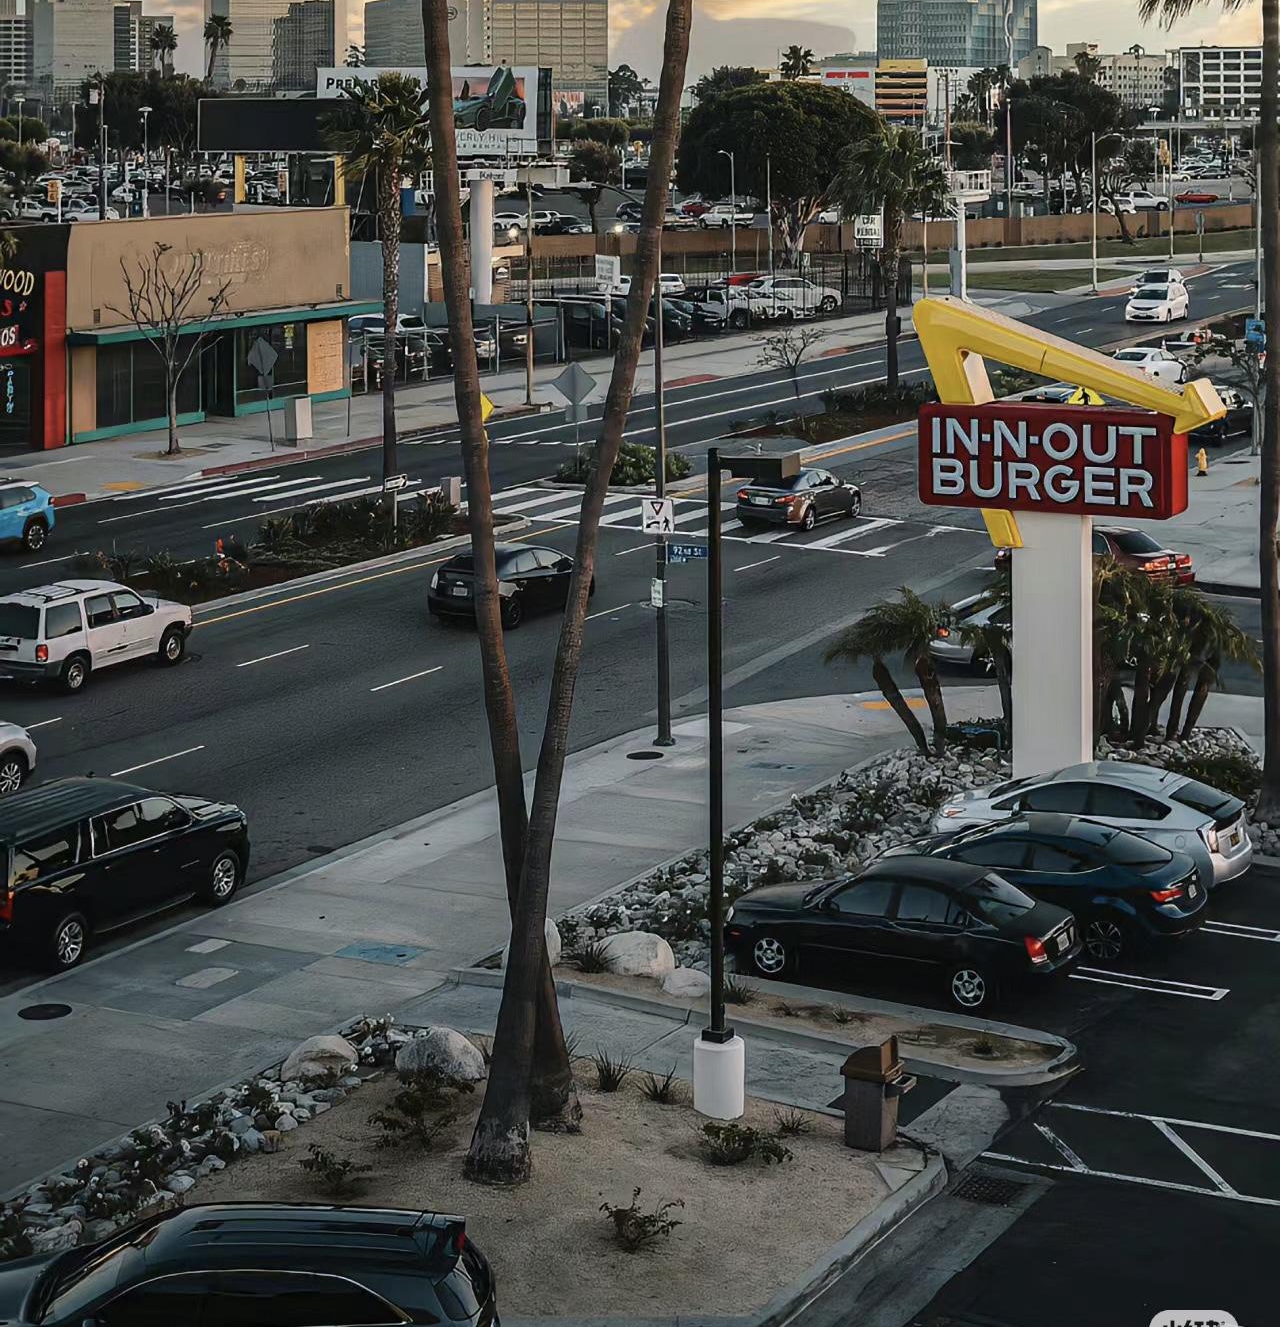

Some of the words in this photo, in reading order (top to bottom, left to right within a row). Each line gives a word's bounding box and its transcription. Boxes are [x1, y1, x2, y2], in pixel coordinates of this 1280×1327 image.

[931, 417, 1157, 465] IN-N-OUT
[931, 457, 1154, 508] BURGER
[672, 545, 692, 555] 92nd
